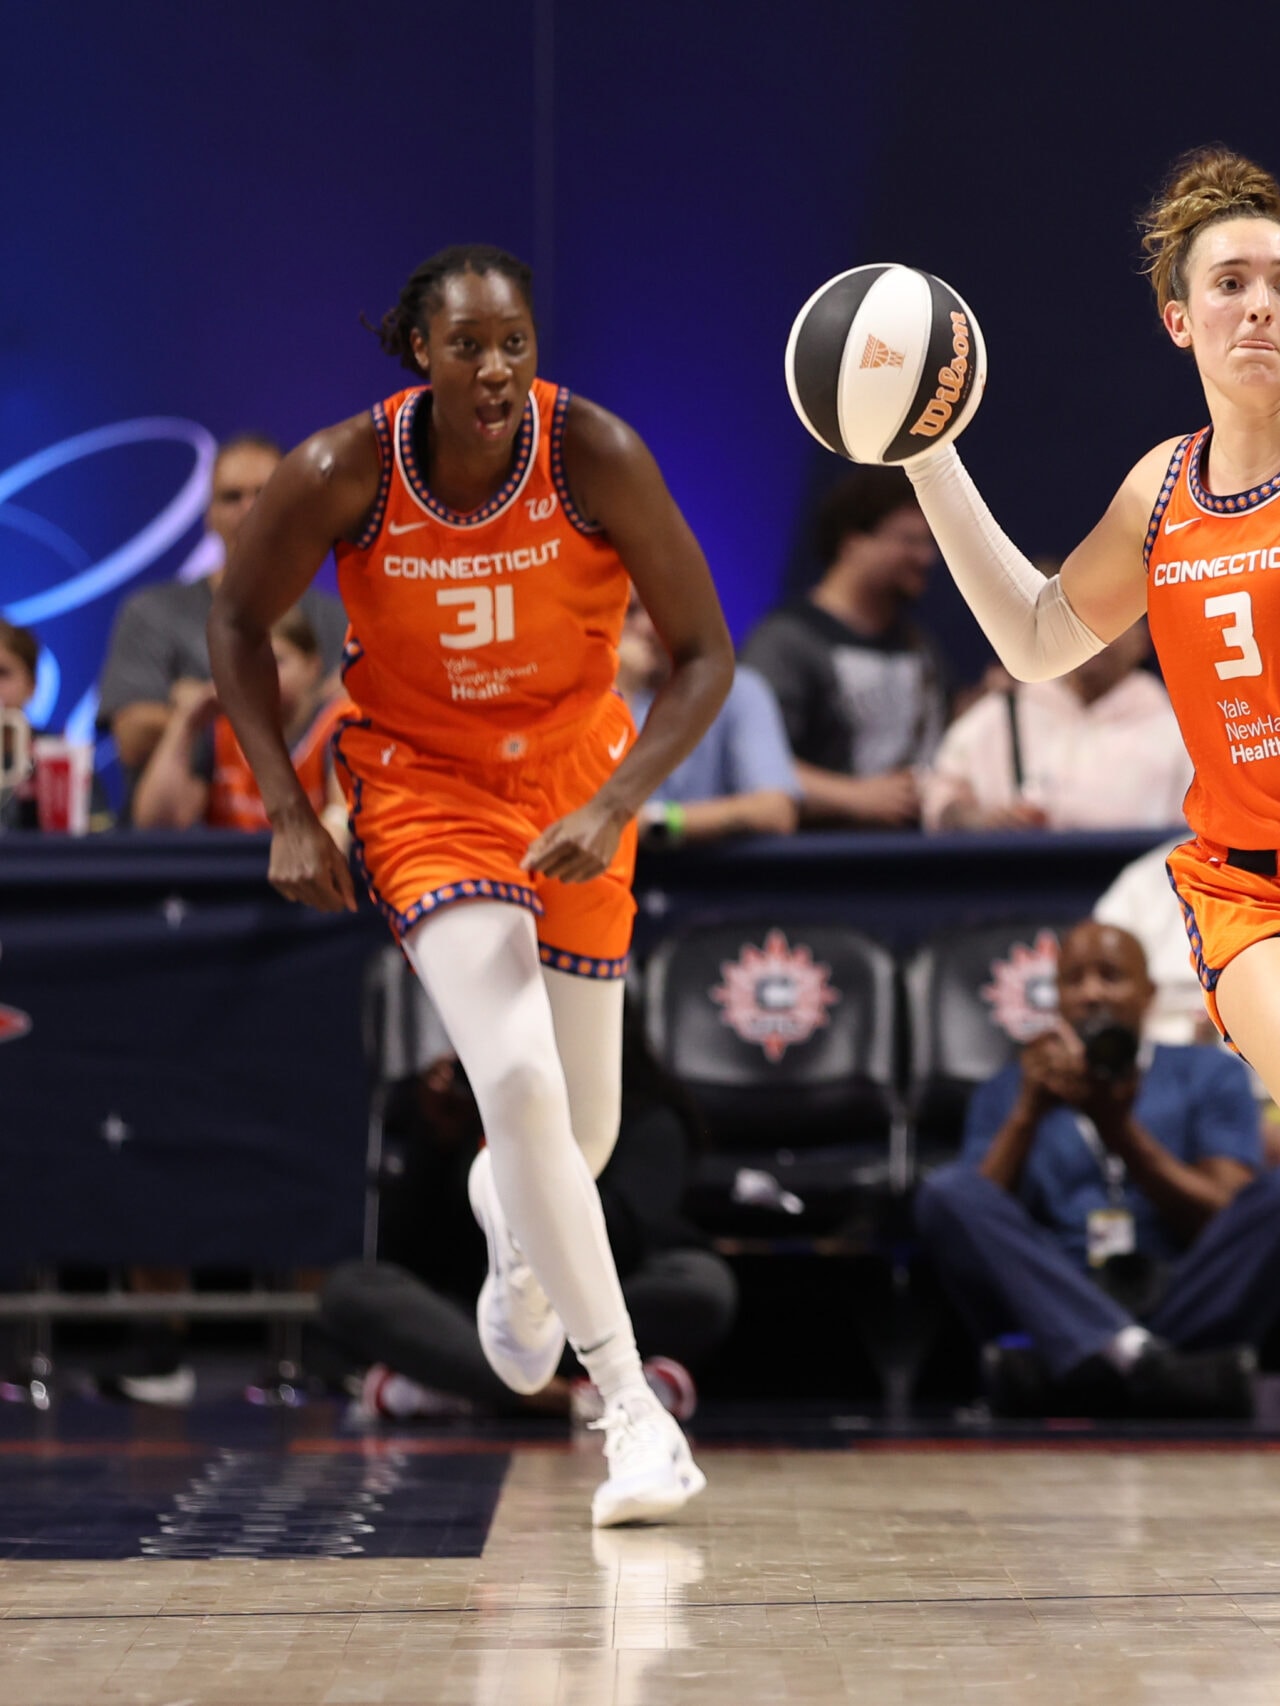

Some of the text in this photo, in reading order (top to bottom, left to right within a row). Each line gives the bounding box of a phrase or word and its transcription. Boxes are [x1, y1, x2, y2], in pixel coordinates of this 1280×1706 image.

[909, 311, 970, 437] Wilson
[383, 538, 561, 580] CONNECTICUT
[436, 584, 515, 650] 31
[1204, 591, 1263, 681] 3
[1217, 697, 1251, 719] Yale
